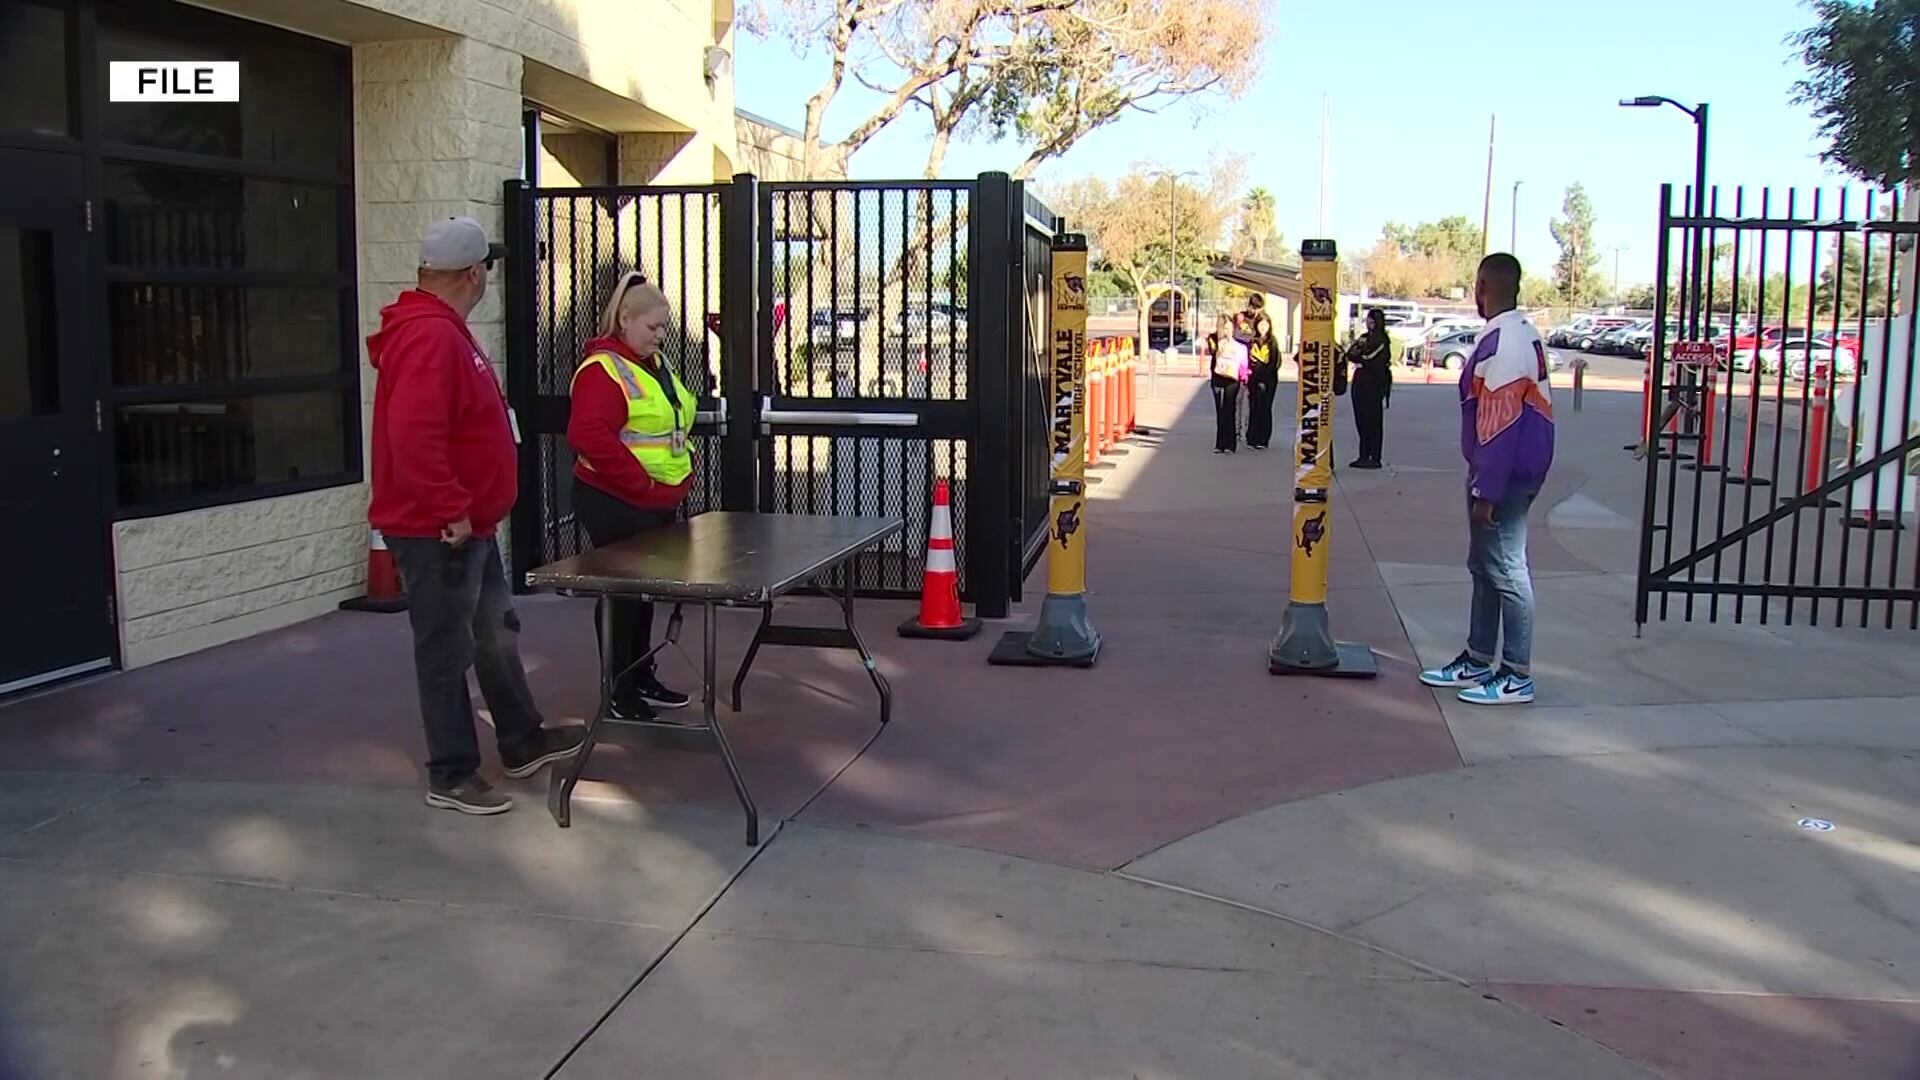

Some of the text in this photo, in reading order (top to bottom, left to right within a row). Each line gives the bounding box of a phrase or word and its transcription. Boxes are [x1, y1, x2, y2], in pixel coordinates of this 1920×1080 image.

[1054, 329, 1073, 454] MARYVALE
[1073, 332, 1083, 414] HIGH SCHOOL
[1320, 344, 1330, 427] HIGH SCHOOL
[1675, 352, 1713, 361] ACCESS
[1300, 340, 1320, 465] MARYVALE
